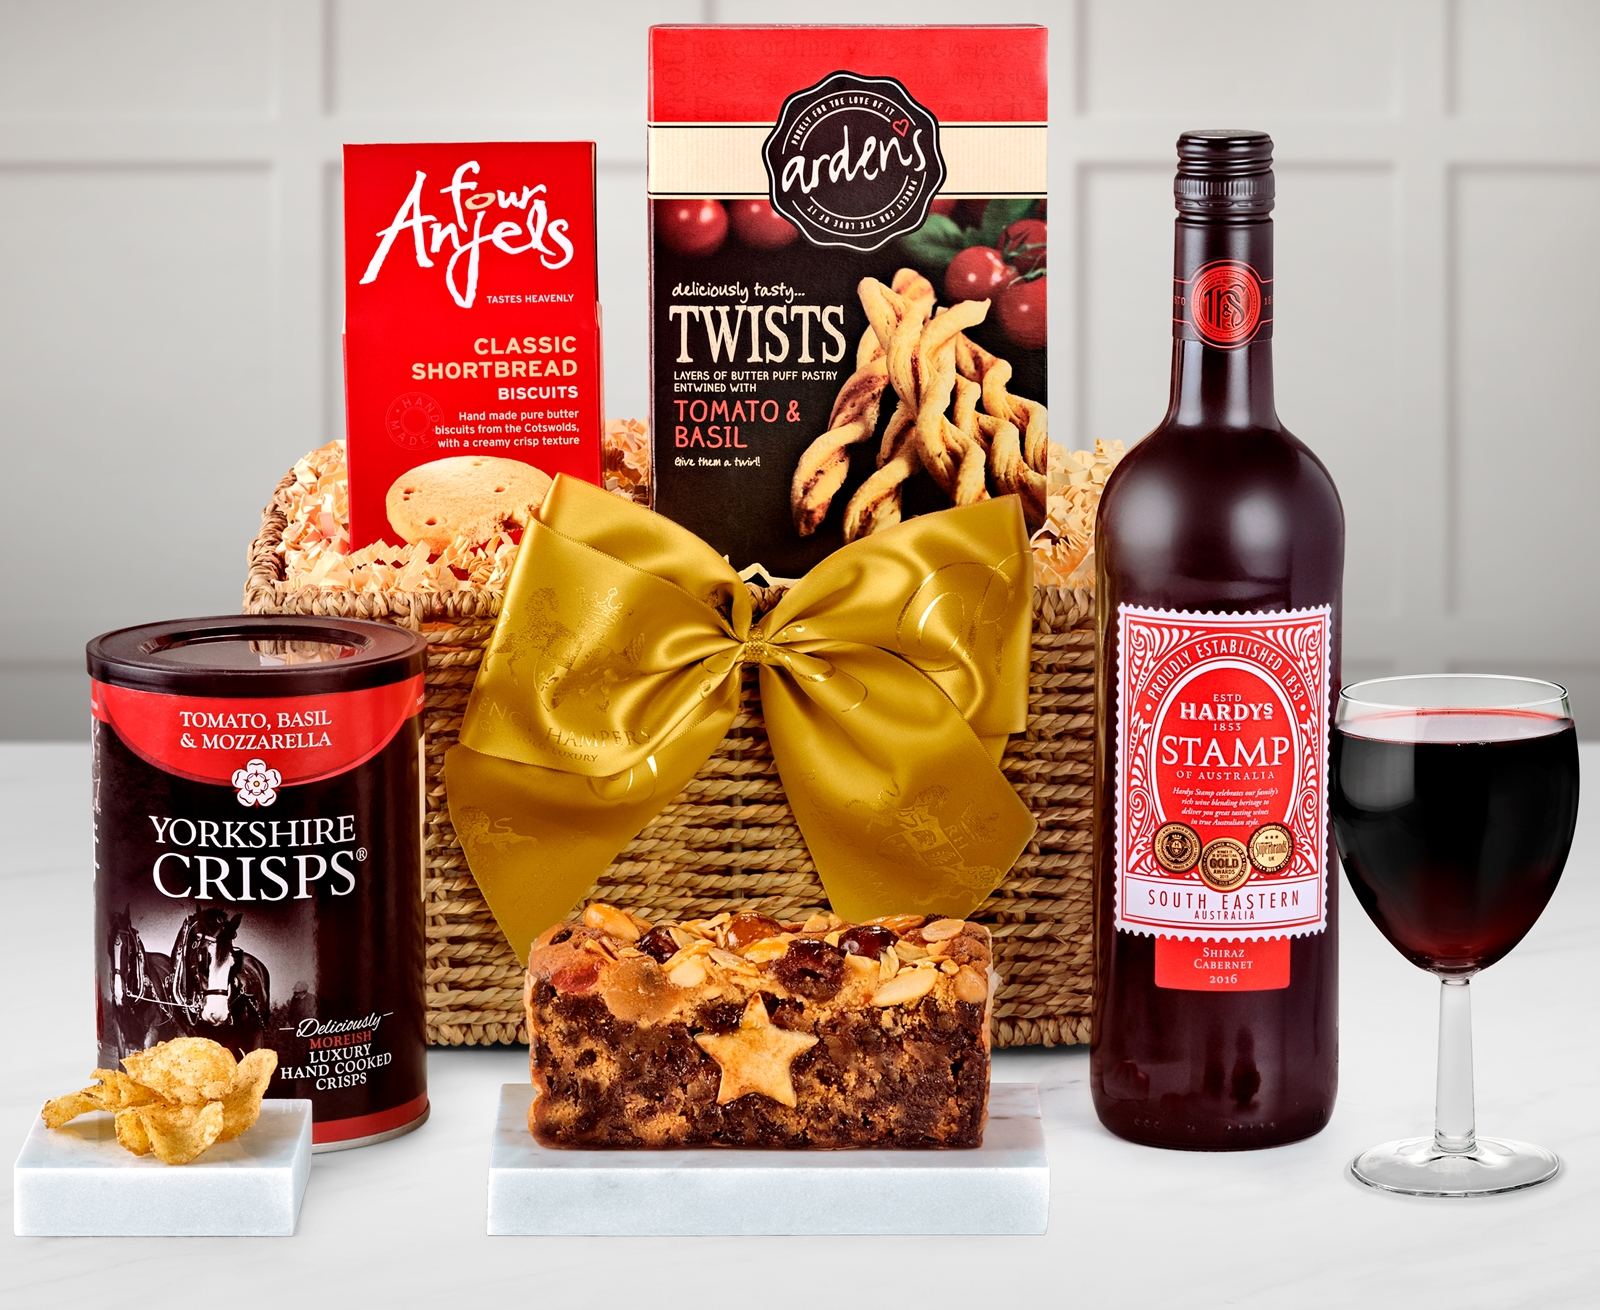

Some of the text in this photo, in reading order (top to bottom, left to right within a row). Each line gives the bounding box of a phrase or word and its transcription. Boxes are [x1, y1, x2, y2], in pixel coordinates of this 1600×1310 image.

[791, 96, 895, 145] PURELY FOR THE LOVE OF IT
[441, 160, 546, 232] four
[807, 180, 918, 230] PURELY FOR THE LOVE OF IT
[359, 170, 574, 309] Anjels
[486, 293, 574, 304] TASTES HEAVENLY
[672, 281, 805, 304] deliciously tasty...
[668, 304, 847, 363] TWISTS
[473, 336, 578, 355] CLASSIC
[411, 359, 578, 380] SHORTBREAD
[674, 371, 838, 381] LAYERS OF BUTTER PUFF PASTRY
[498, 386, 579, 400] BISCUITS
[674, 383, 757, 393] ENTWINED WITH
[459, 409, 579, 422] Hand made pure butter
[674, 400, 801, 423] TOMATO &
[435, 422, 580, 435] biscuits from the Cotswolds,
[674, 426, 749, 448] BASIL
[437, 438, 460, 448] with
[472, 439, 510, 449] creamy
[513, 437, 539, 448] crisp
[542, 436, 580, 446] texture
[674, 456, 761, 467] Give them a twirl!
[1147, 638, 1305, 701] PROUDLY ESTABLISHED 1853
[1213, 693, 1242, 702] ESTD
[180, 709, 333, 731] TOMATO, BASIL
[1213, 722, 1242, 732] 1853
[180, 731, 333, 750] & MOZZARELLA
[545, 726, 652, 748] HAMPERS
[551, 750, 599, 763] LUXURY
[1160, 734, 1291, 769] STAMP
[1176, 771, 1275, 780] OF AUSTRALIA
[1172, 787, 1194, 797] Hardys
[1195, 788, 1215, 799] Stamp
[1216, 788, 1244, 797] celebrates
[1255, 787, 1279, 798] family's
[1211, 798, 1238, 808] blending
[1239, 798, 1262, 807] heritage
[1181, 807, 1202, 815] deliver
[1202, 809, 1214, 818] you
[1214, 809, 1231, 819] great
[1231, 808, 1252, 818] tasting
[148, 814, 356, 848] YORKSHIRE
[1212, 818, 1245, 826] Australian
[1245, 818, 1260, 828] style.
[1210, 858, 1239, 868] GOLD
[1148, 887, 1300, 911] SOUTH EASTERN
[1194, 909, 1256, 921] AUSTRALIA
[1202, 946, 1245, 958] SHIRAZ
[1193, 958, 1254, 970] CABERNET
[1209, 973, 1239, 985] 2016
[296, 1012, 382, 1038] Deliciously
[309, 1030, 373, 1050] MOREISH
[309, 1043, 372, 1064] LUXURY
[280, 1052, 392, 1080] HAND COOKED
[315, 1072, 368, 1091] CRISPS
